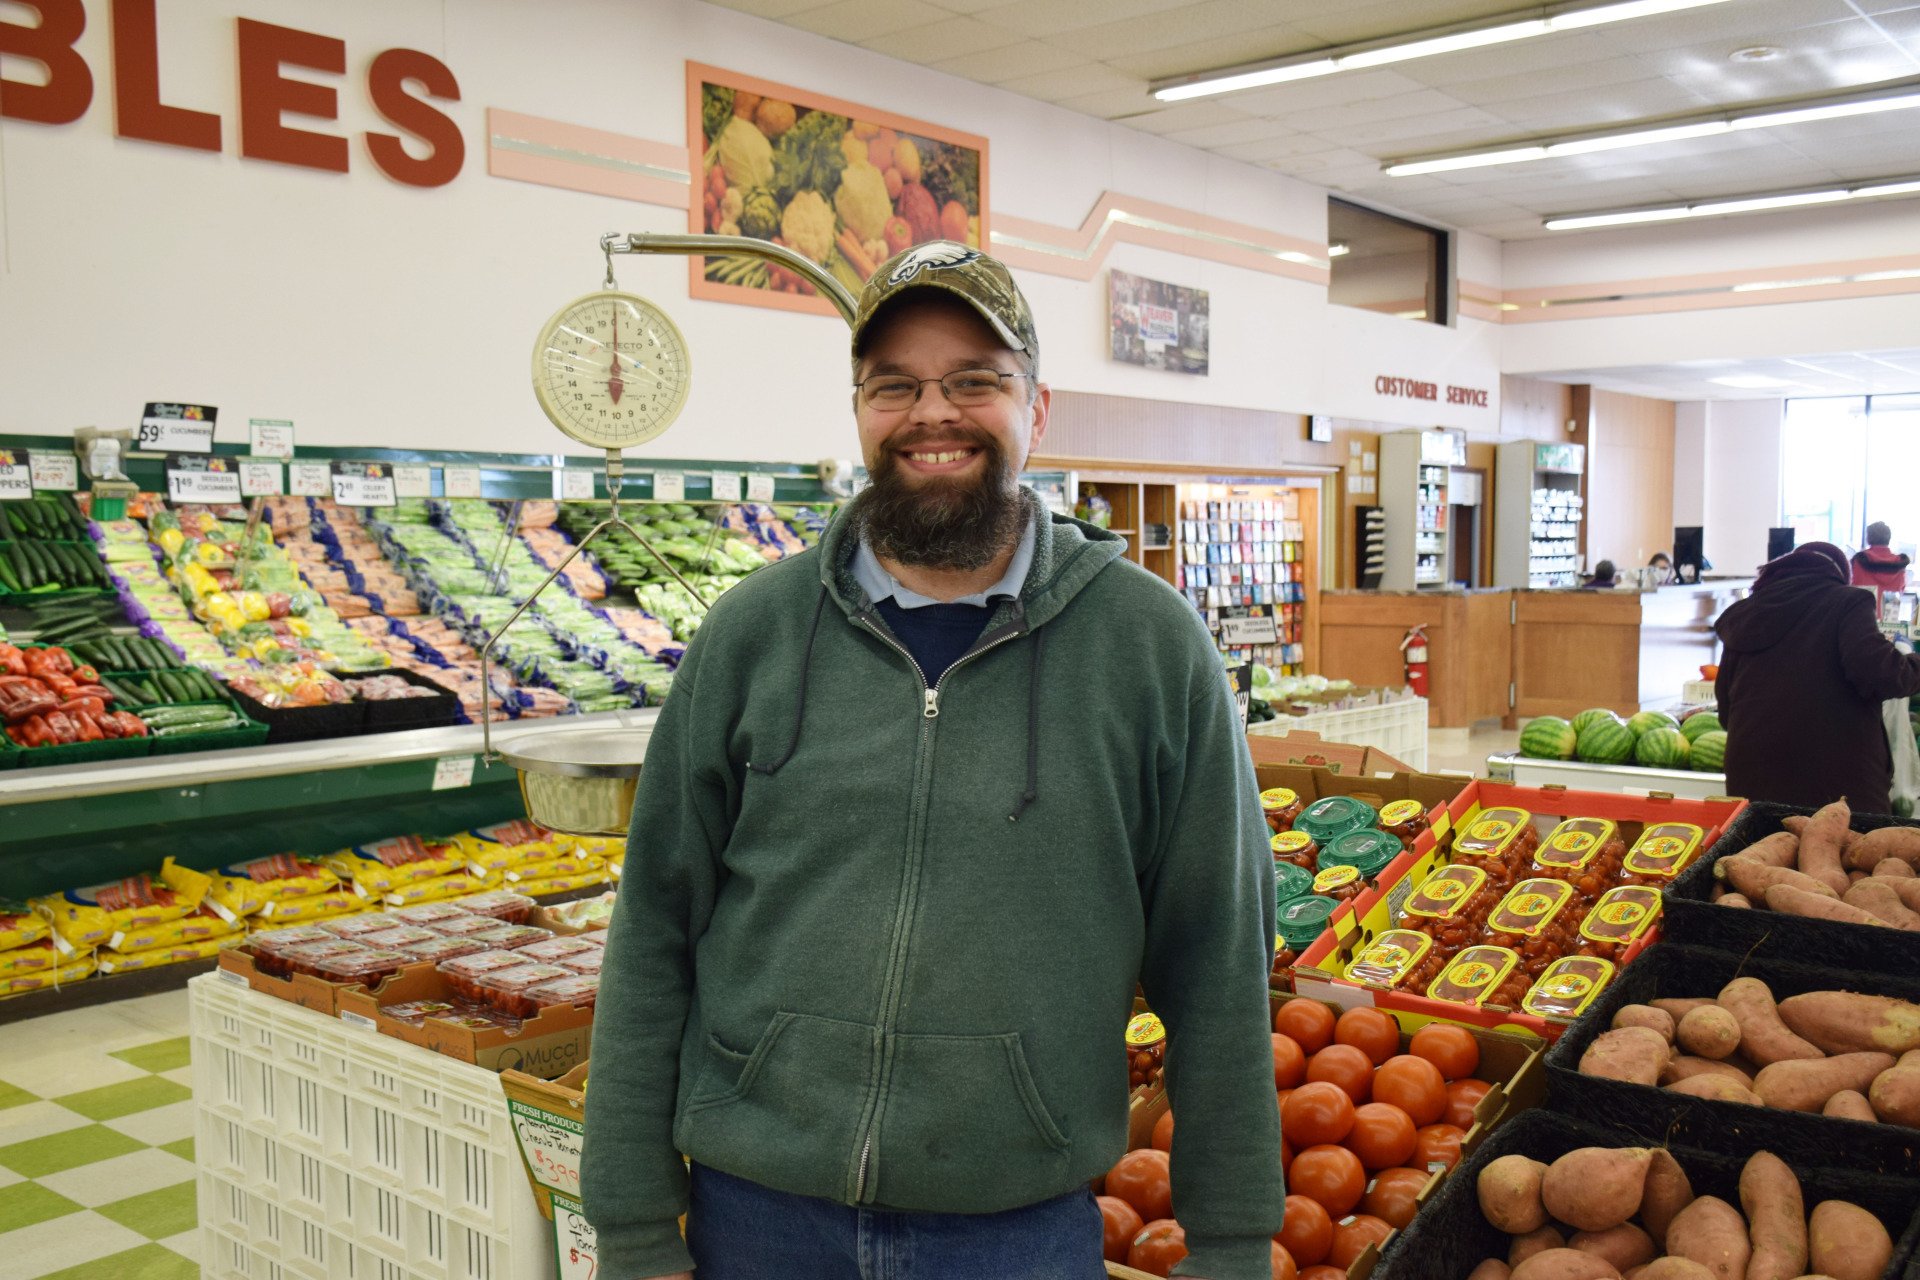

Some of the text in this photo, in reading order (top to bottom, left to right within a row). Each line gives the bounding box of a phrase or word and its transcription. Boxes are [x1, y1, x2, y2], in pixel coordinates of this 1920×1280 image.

[625, 321, 629, 329] 1
[585, 326, 594, 334] 18
[637, 328, 643, 336] 2
[575, 336, 583, 344] 17
[648, 338, 654, 347] 3
[564, 365, 574, 373] 15
[658, 367, 664, 375] 5
[568, 380, 577, 388] 14
[656, 381, 662, 390] 6
[1375, 375, 1488, 408] CUSTOMER SERVICE
[574, 393, 583, 401] 13
[652, 394, 657, 402] 7
[583, 403, 592, 411] 12
[640, 403, 647, 412] 8
[599, 409, 606, 417] 11
[612, 411, 621, 420] 10
[628, 409, 634, 418] 9
[0, 479, 29, 490] PERS
[512, 1102, 541, 1119] FRESH
[541, 1111, 584, 1133] PRODUCE
